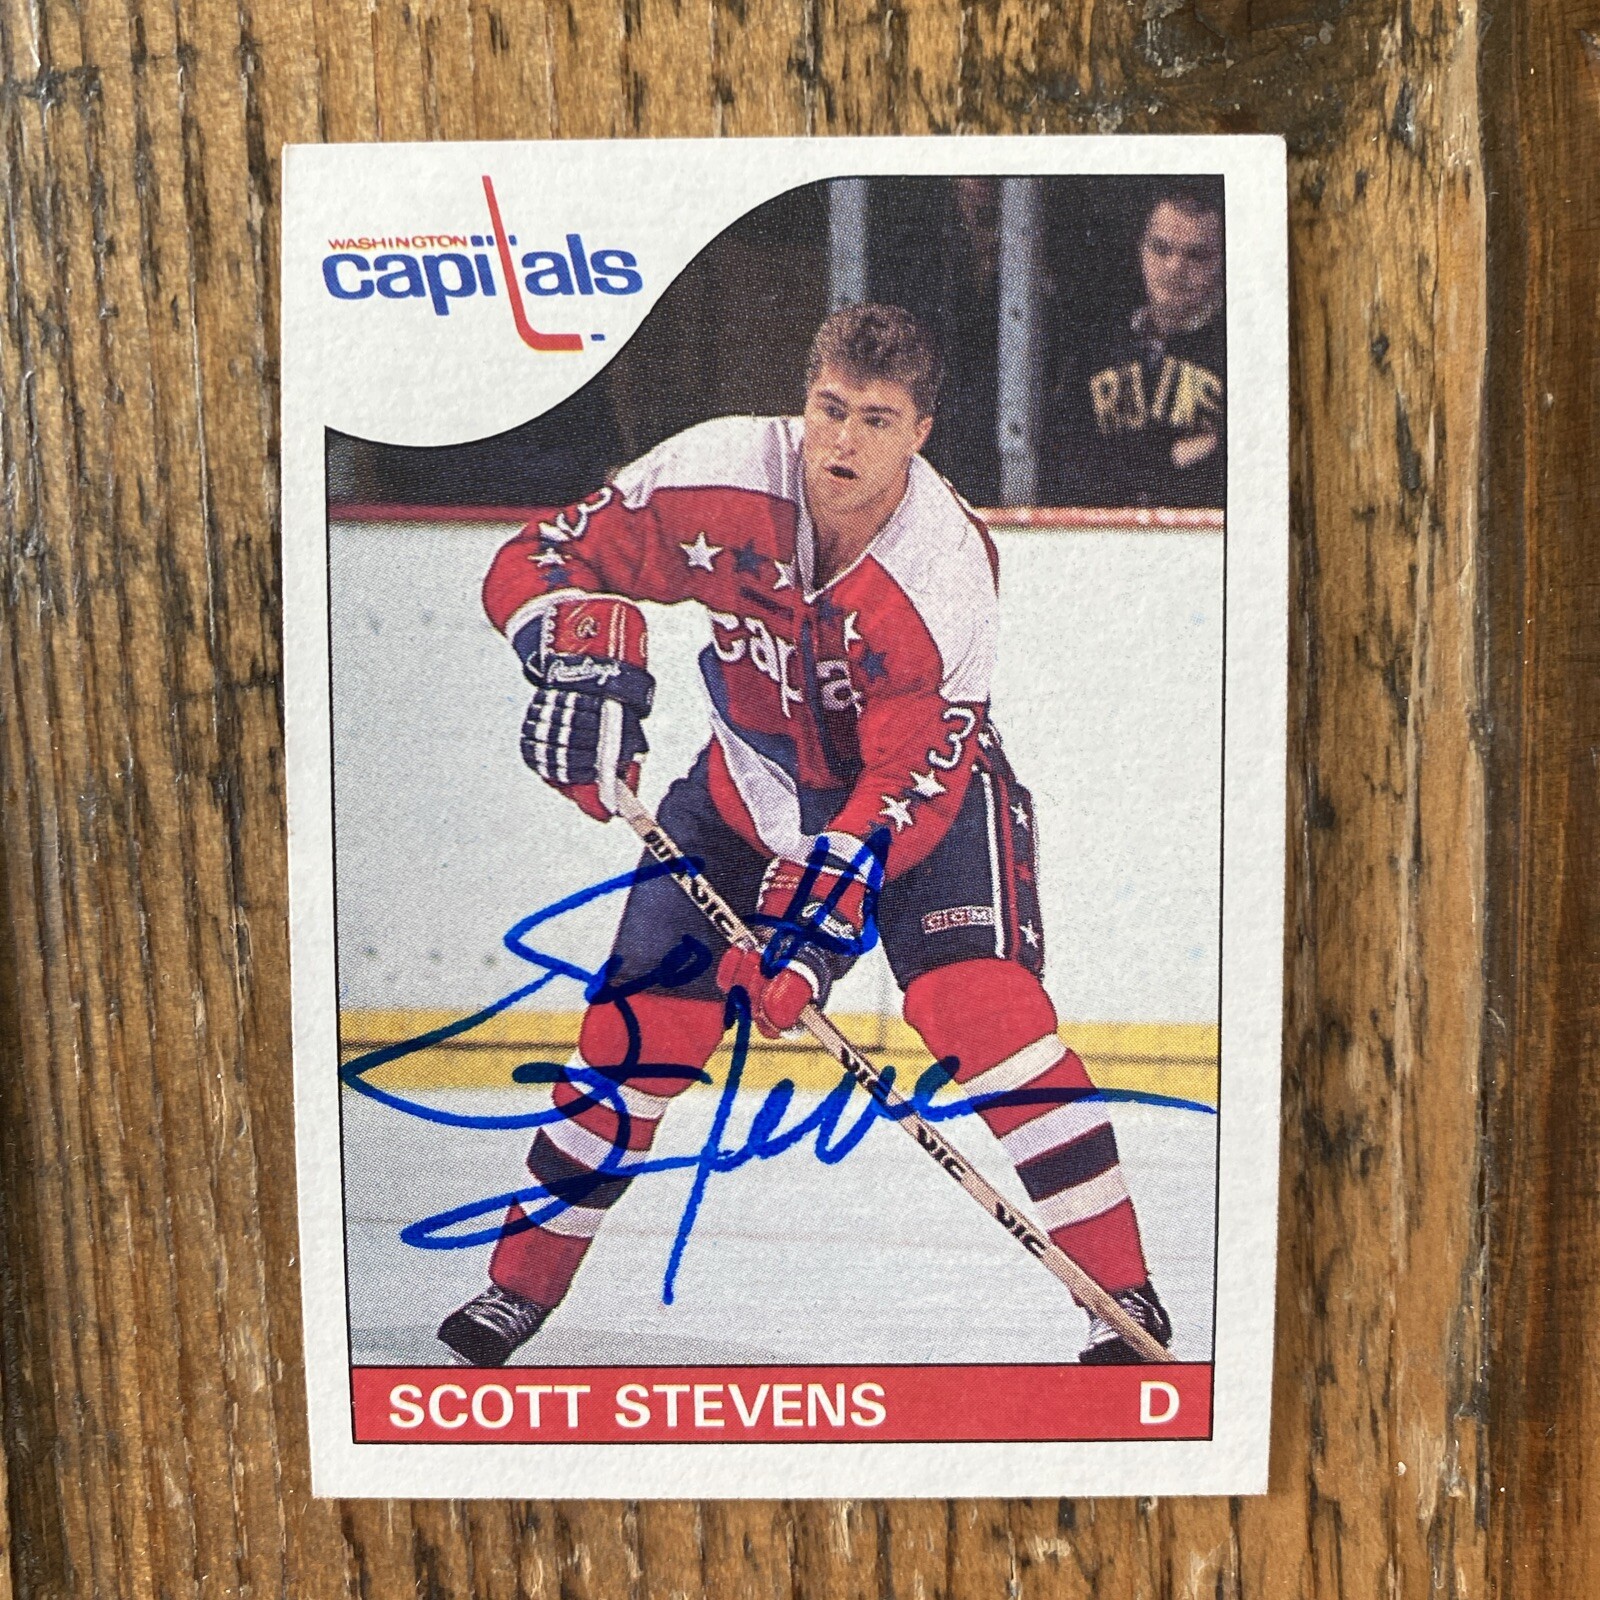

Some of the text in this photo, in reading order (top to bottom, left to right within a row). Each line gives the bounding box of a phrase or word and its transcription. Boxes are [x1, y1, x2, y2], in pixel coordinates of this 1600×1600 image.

[328, 235, 468, 250] WASHINGTON
[927, 706, 977, 770] 3
[917, 1123, 967, 1183] VIC
[995, 1201, 1048, 1259] VIC
[388, 1381, 1181, 1429] SCOTT STEVENS D
